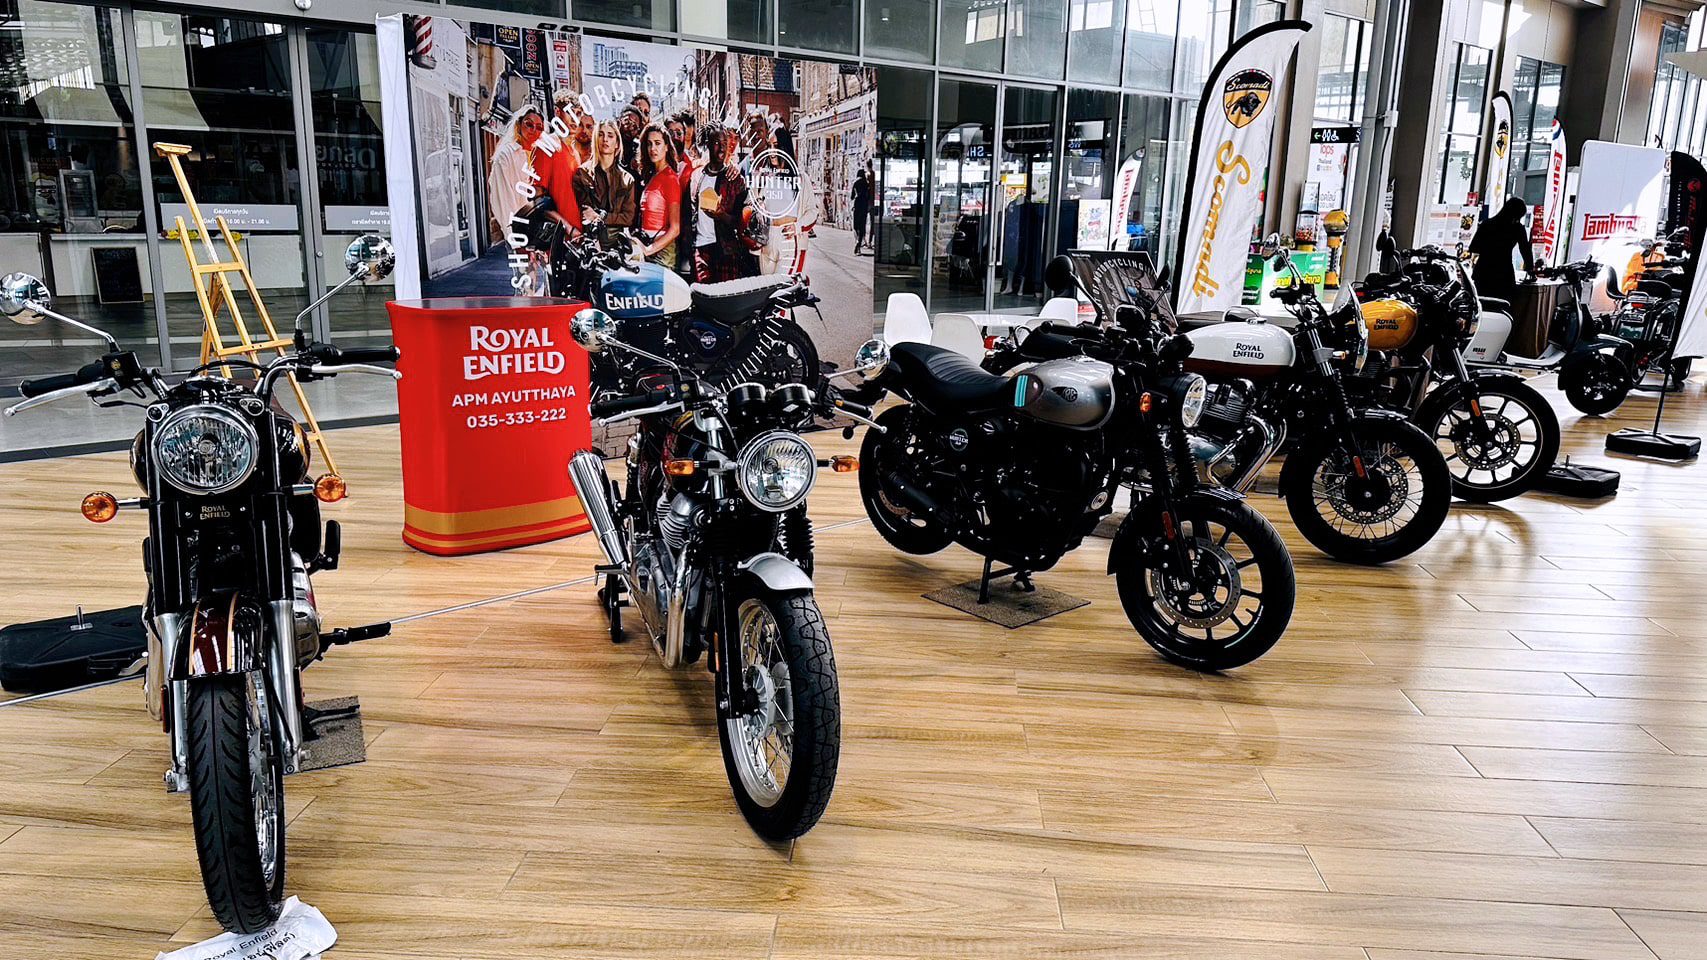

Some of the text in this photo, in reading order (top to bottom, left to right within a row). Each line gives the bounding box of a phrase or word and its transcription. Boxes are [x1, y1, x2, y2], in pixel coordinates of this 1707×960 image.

[533, 75, 712, 158] MOTORCYCLING
[515, 162, 541, 199] OF
[1192, 139, 1251, 298] Scomadi
[507, 212, 531, 290] SHOT
[605, 292, 665, 310] ENFIELD
[470, 325, 554, 352] ROYAL
[1236, 342, 1262, 352] ROYAL
[463, 351, 565, 381] ENFIELD
[1232, 350, 1265, 360] ENFIELD
[451, 385, 576, 408] APM AYUTTHAYA
[466, 408, 567, 429] 035-333-222
[200, 511, 231, 520] ENFIELD
[201, 505, 226, 513] ROYAL
[239, 927, 278, 950] Enfield
